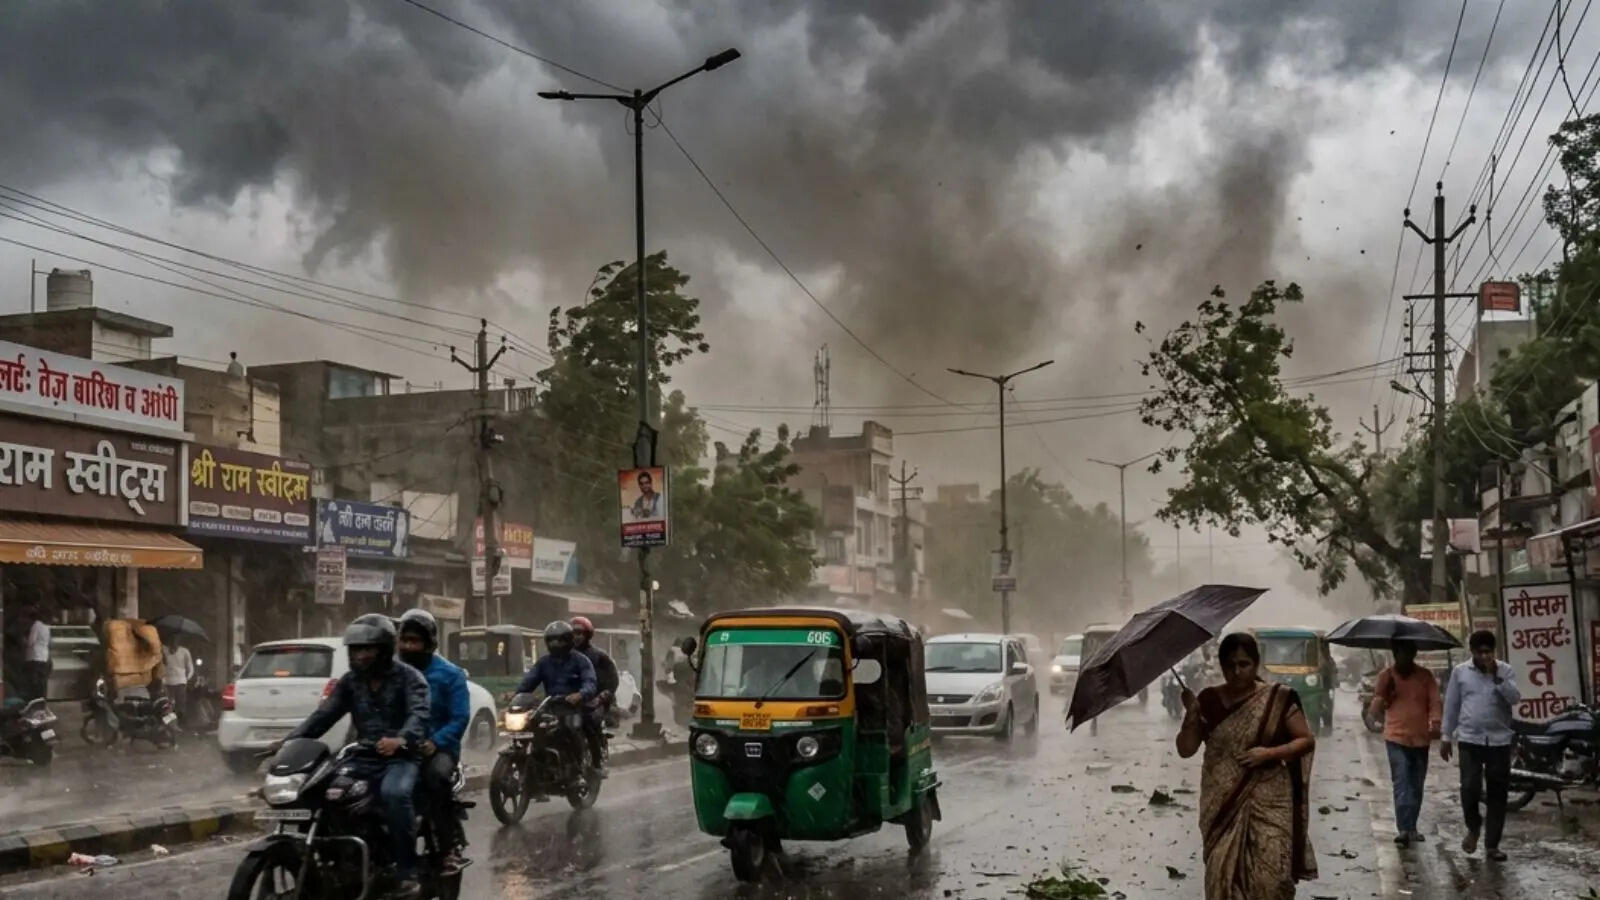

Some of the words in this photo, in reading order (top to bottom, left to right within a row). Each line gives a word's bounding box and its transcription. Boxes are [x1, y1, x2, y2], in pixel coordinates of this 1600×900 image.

[38, 358, 69, 406] तेज़
[124, 385, 137, 413] व
[0, 442, 55, 489] राम
[65, 439, 168, 515] स्वीट्स
[191, 449, 216, 489] श्री
[220, 463, 253, 494] राम
[1527, 652, 1555, 686] ते
